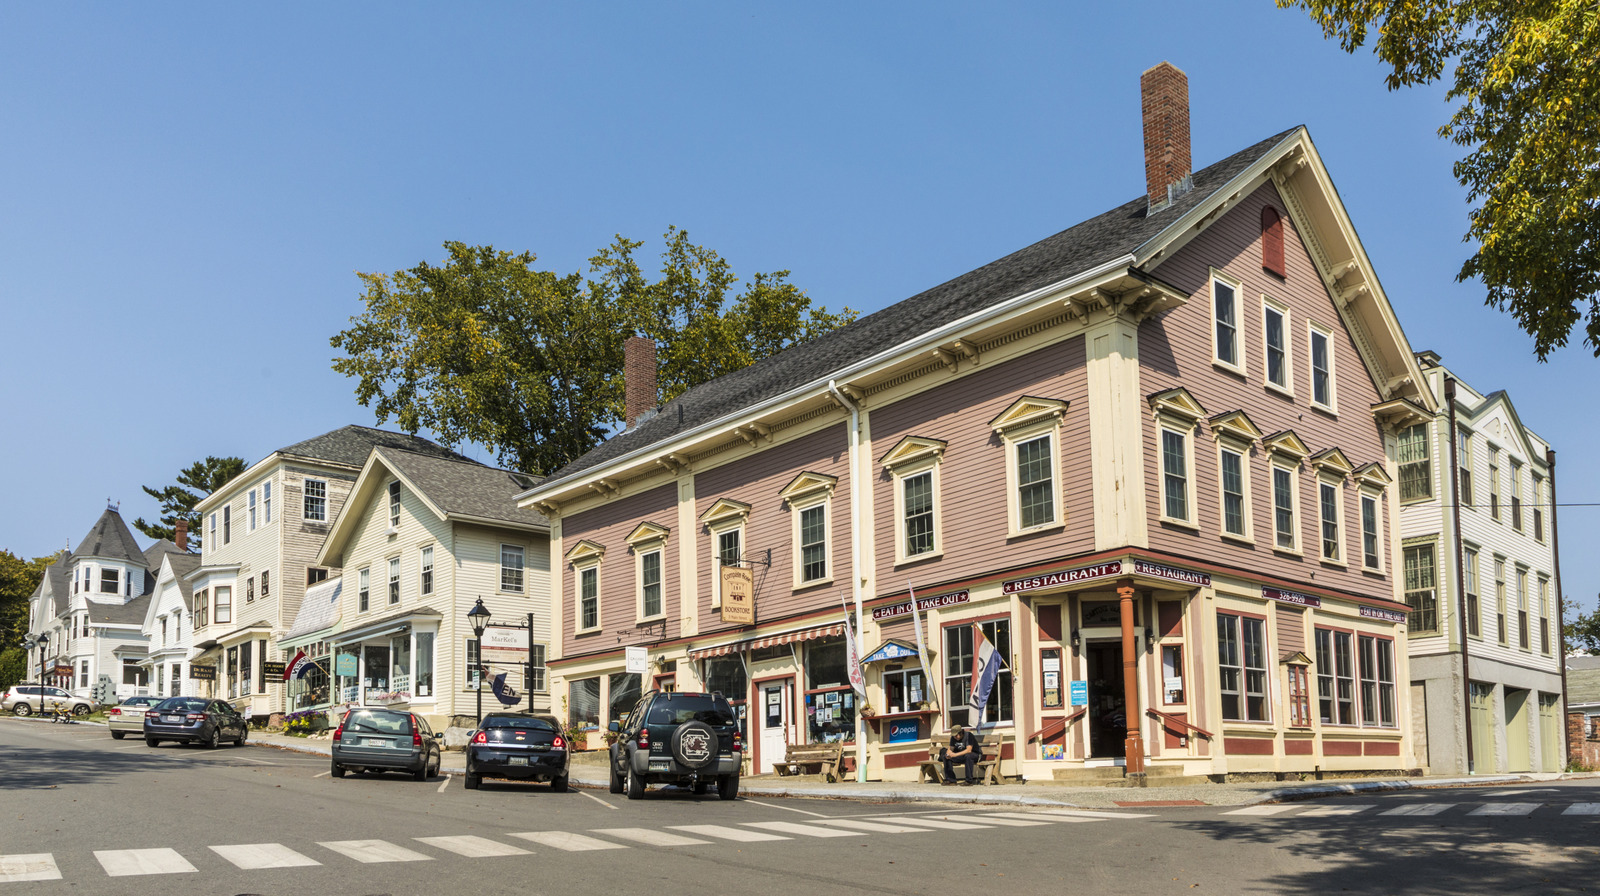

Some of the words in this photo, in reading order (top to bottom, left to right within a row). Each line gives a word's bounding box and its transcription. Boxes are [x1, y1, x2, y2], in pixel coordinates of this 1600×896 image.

[1014, 565, 1109, 591] RESTAURANT
[1143, 563, 1204, 584] RESTAURANT
[725, 606, 751, 615] BOOKSTORE
[881, 606, 895, 617] EAT
[896, 605, 905, 614] IN
[919, 597, 941, 609] TAKE
[942, 593, 960, 604] OUT
[899, 725, 917, 735] pepsi
